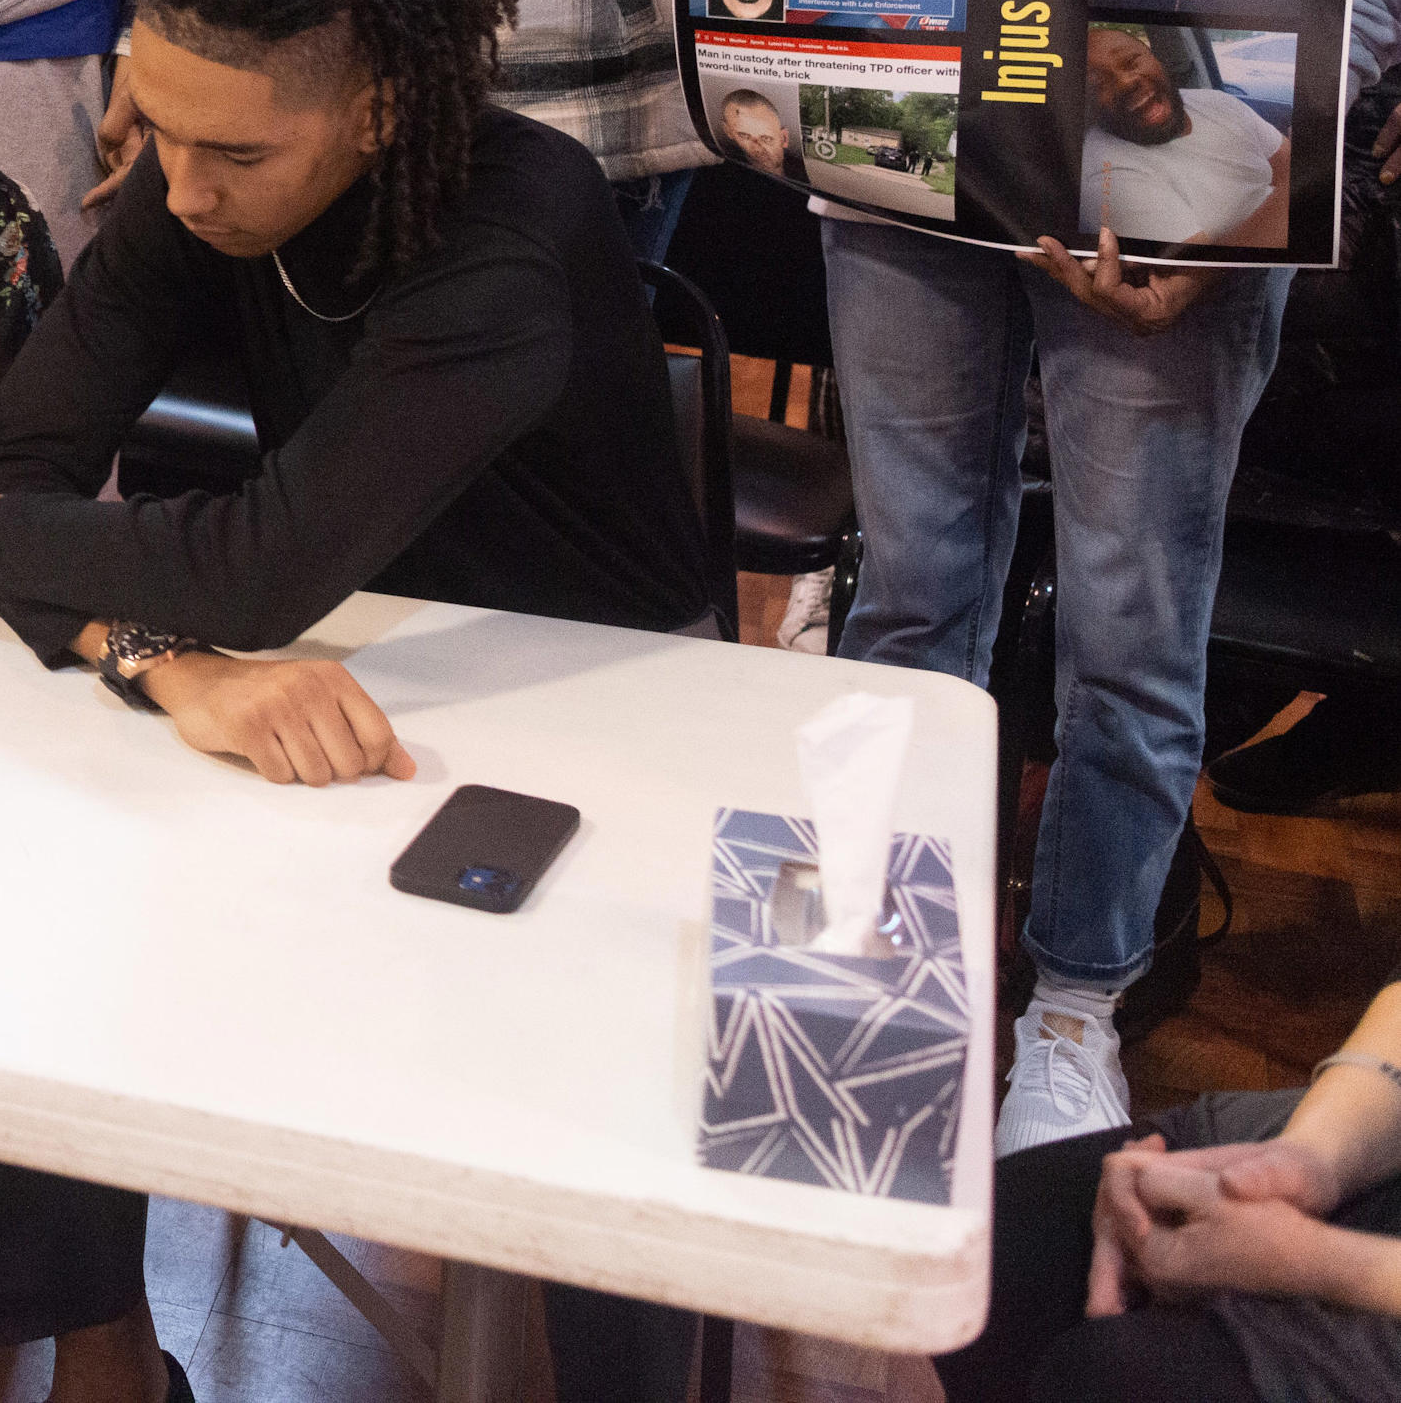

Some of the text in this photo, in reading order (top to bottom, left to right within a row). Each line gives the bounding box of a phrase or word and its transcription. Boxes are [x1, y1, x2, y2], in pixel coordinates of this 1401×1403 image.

[841, 0, 857, 7] with
[875, 1, 921, 10] Enforcement
[698, 48, 960, 77] Man in custody after threatening TPD officer with
[698, 60, 811, 80] sword-like knife, brick
